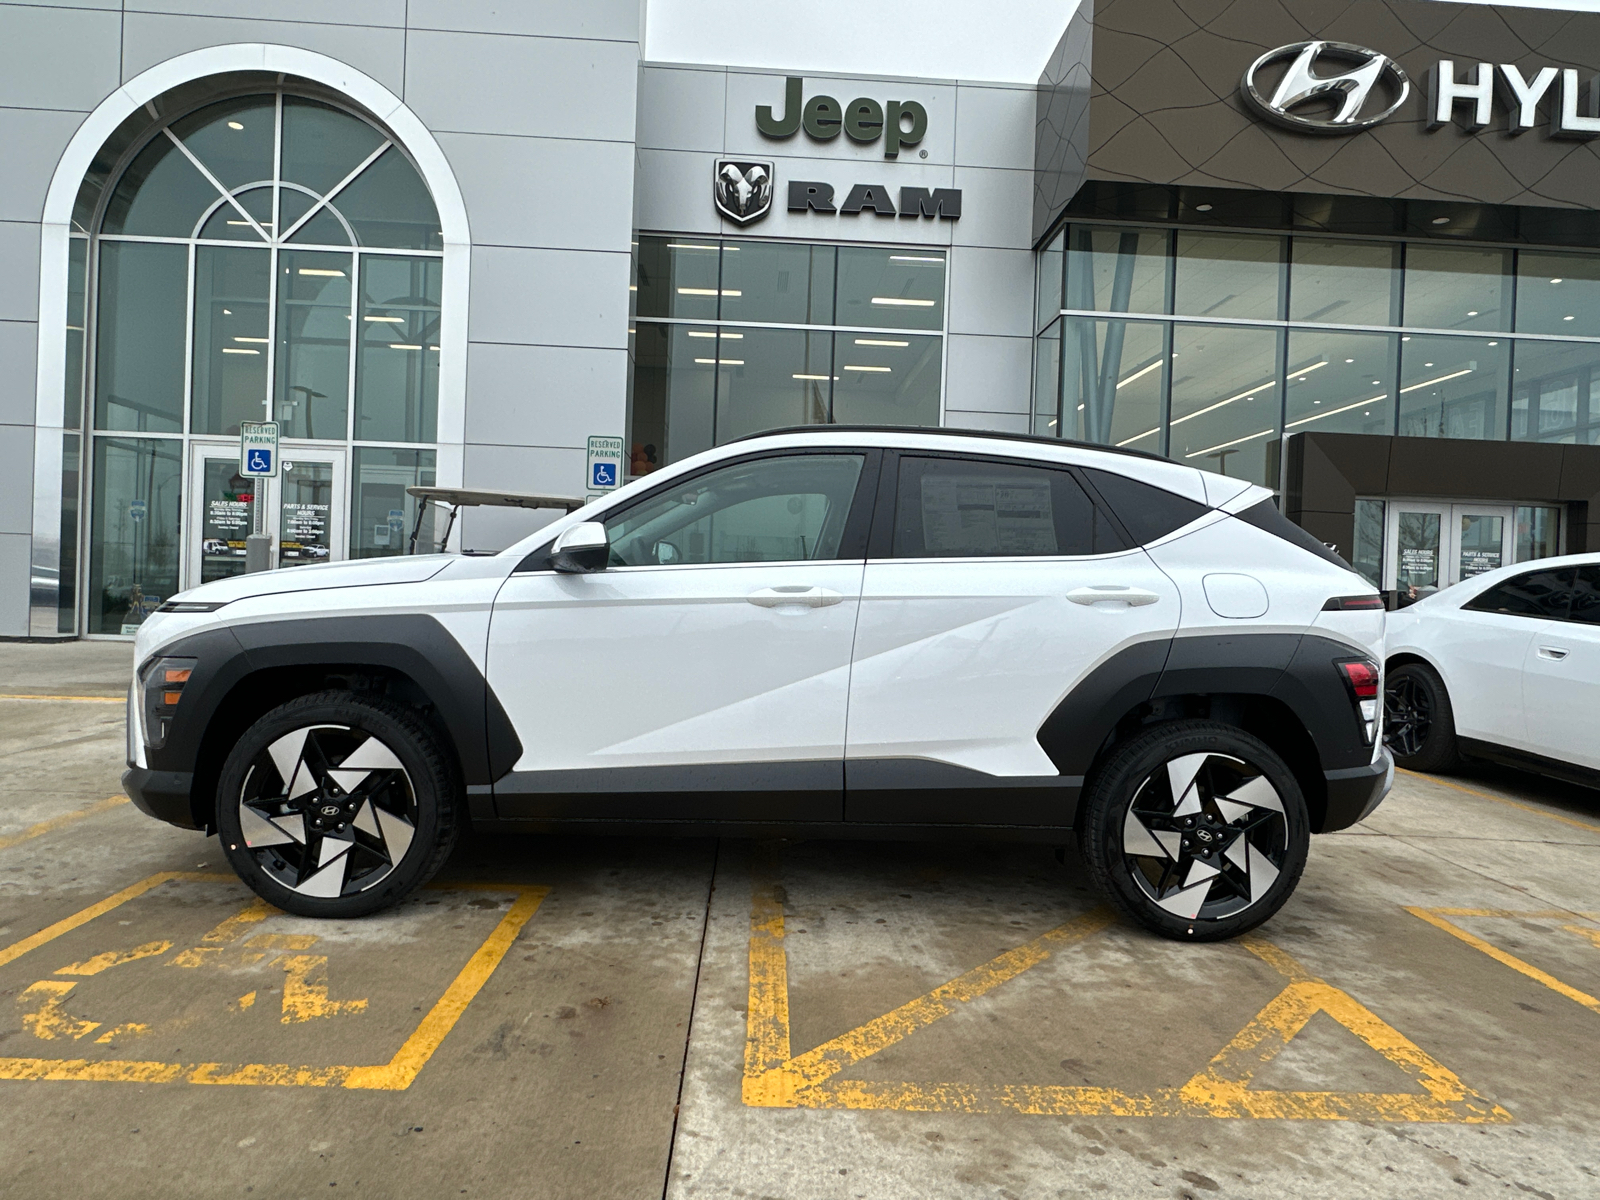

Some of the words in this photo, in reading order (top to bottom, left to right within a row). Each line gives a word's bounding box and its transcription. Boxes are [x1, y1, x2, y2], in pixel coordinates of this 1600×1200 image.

[755, 76, 929, 159] Jeep
[787, 180, 963, 221] RAM
[244, 426, 276, 435] RESERVED
[244, 436, 276, 445] PARKING
[590, 440, 620, 449] RESERVED
[590, 450, 620, 459] PARKING
